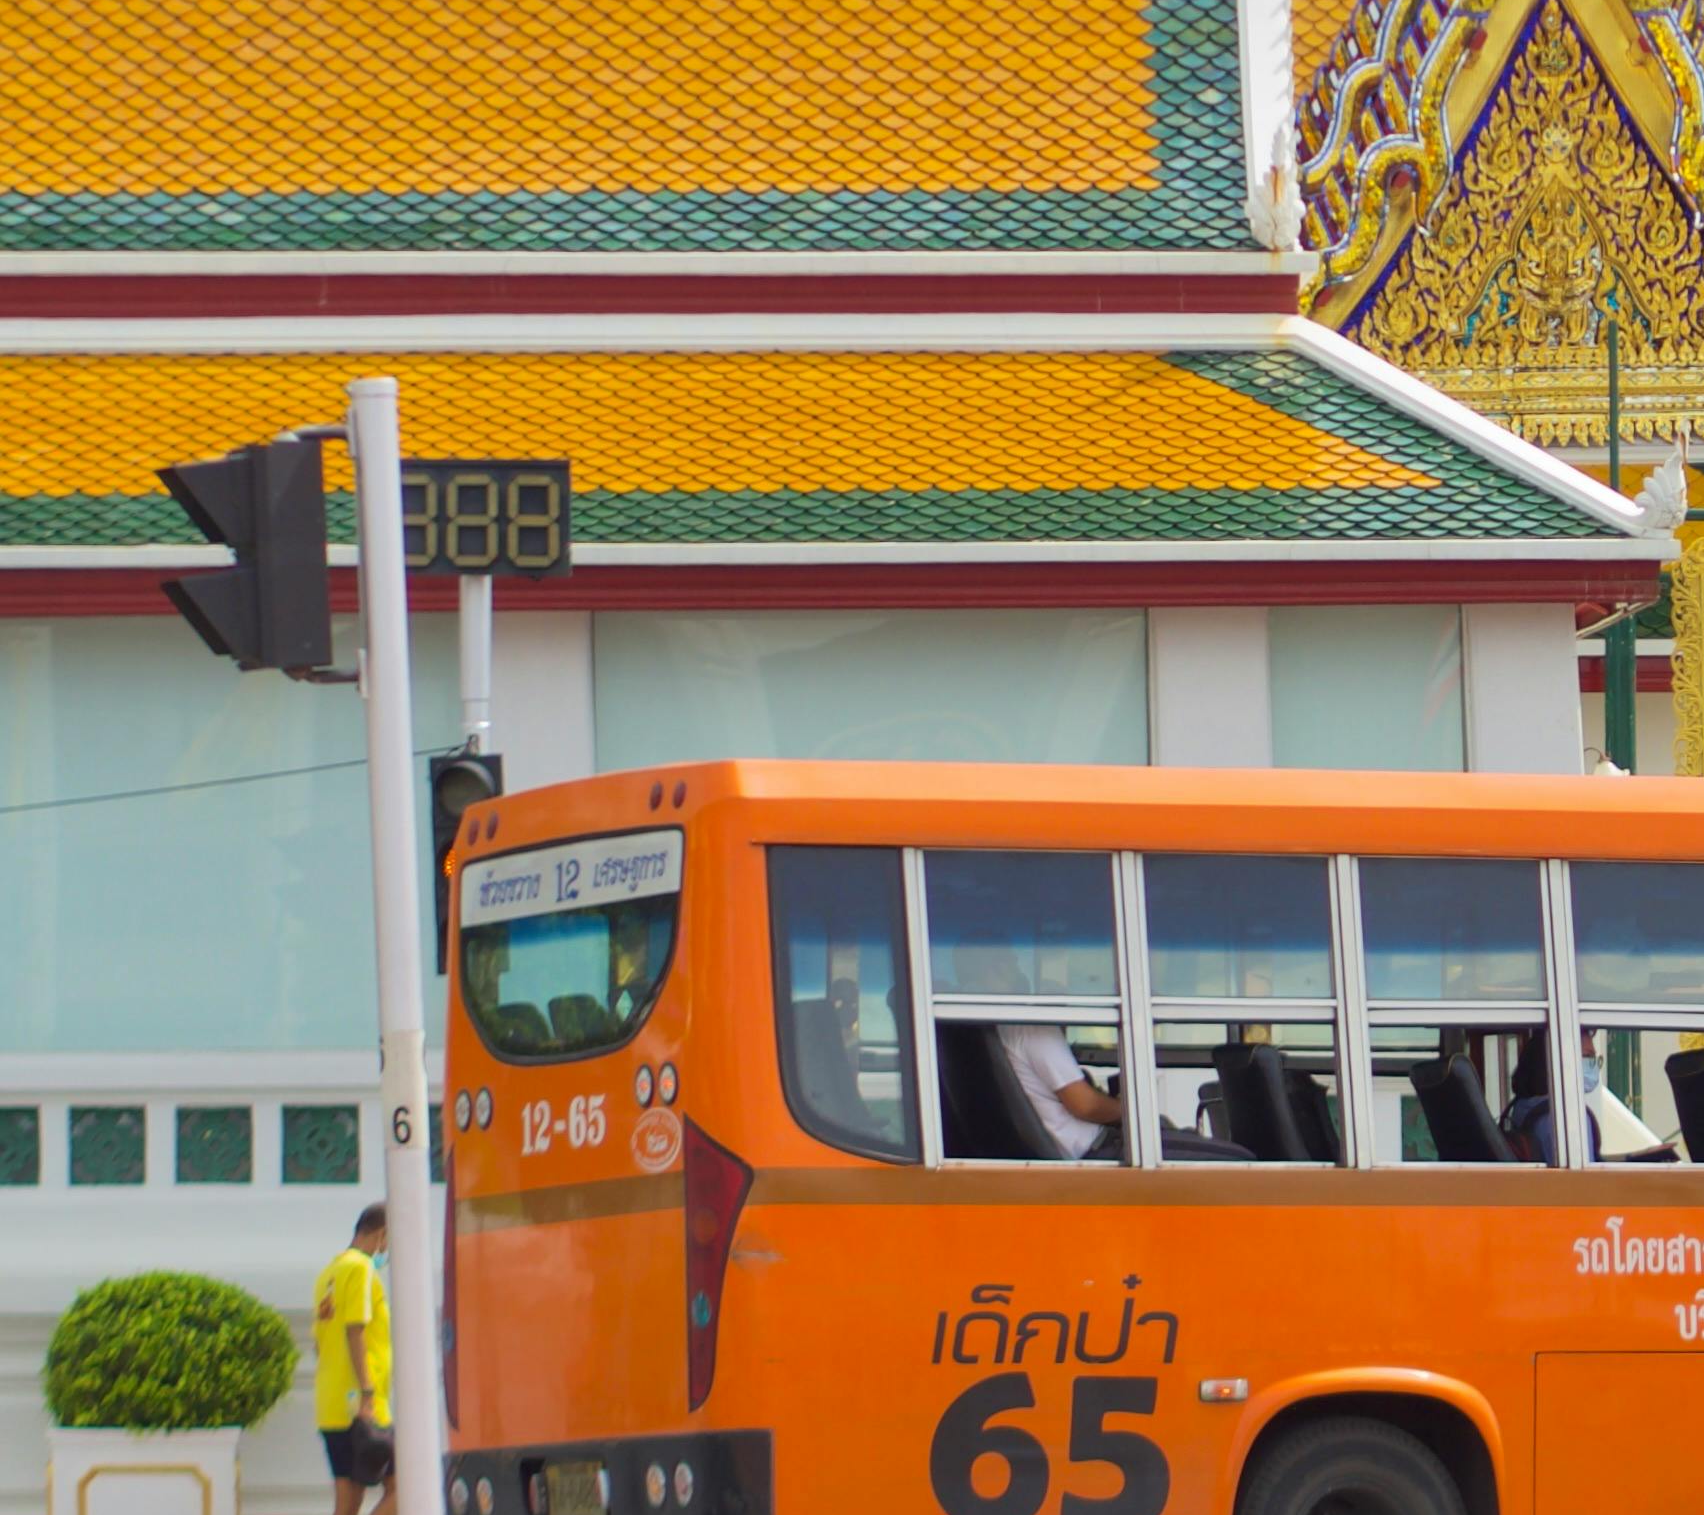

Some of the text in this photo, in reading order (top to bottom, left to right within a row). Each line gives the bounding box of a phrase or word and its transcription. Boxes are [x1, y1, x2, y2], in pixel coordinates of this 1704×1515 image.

[555, 859, 580, 903] 12
[393, 1106, 411, 1144] 6
[520, 1092, 607, 1157] 12-65
